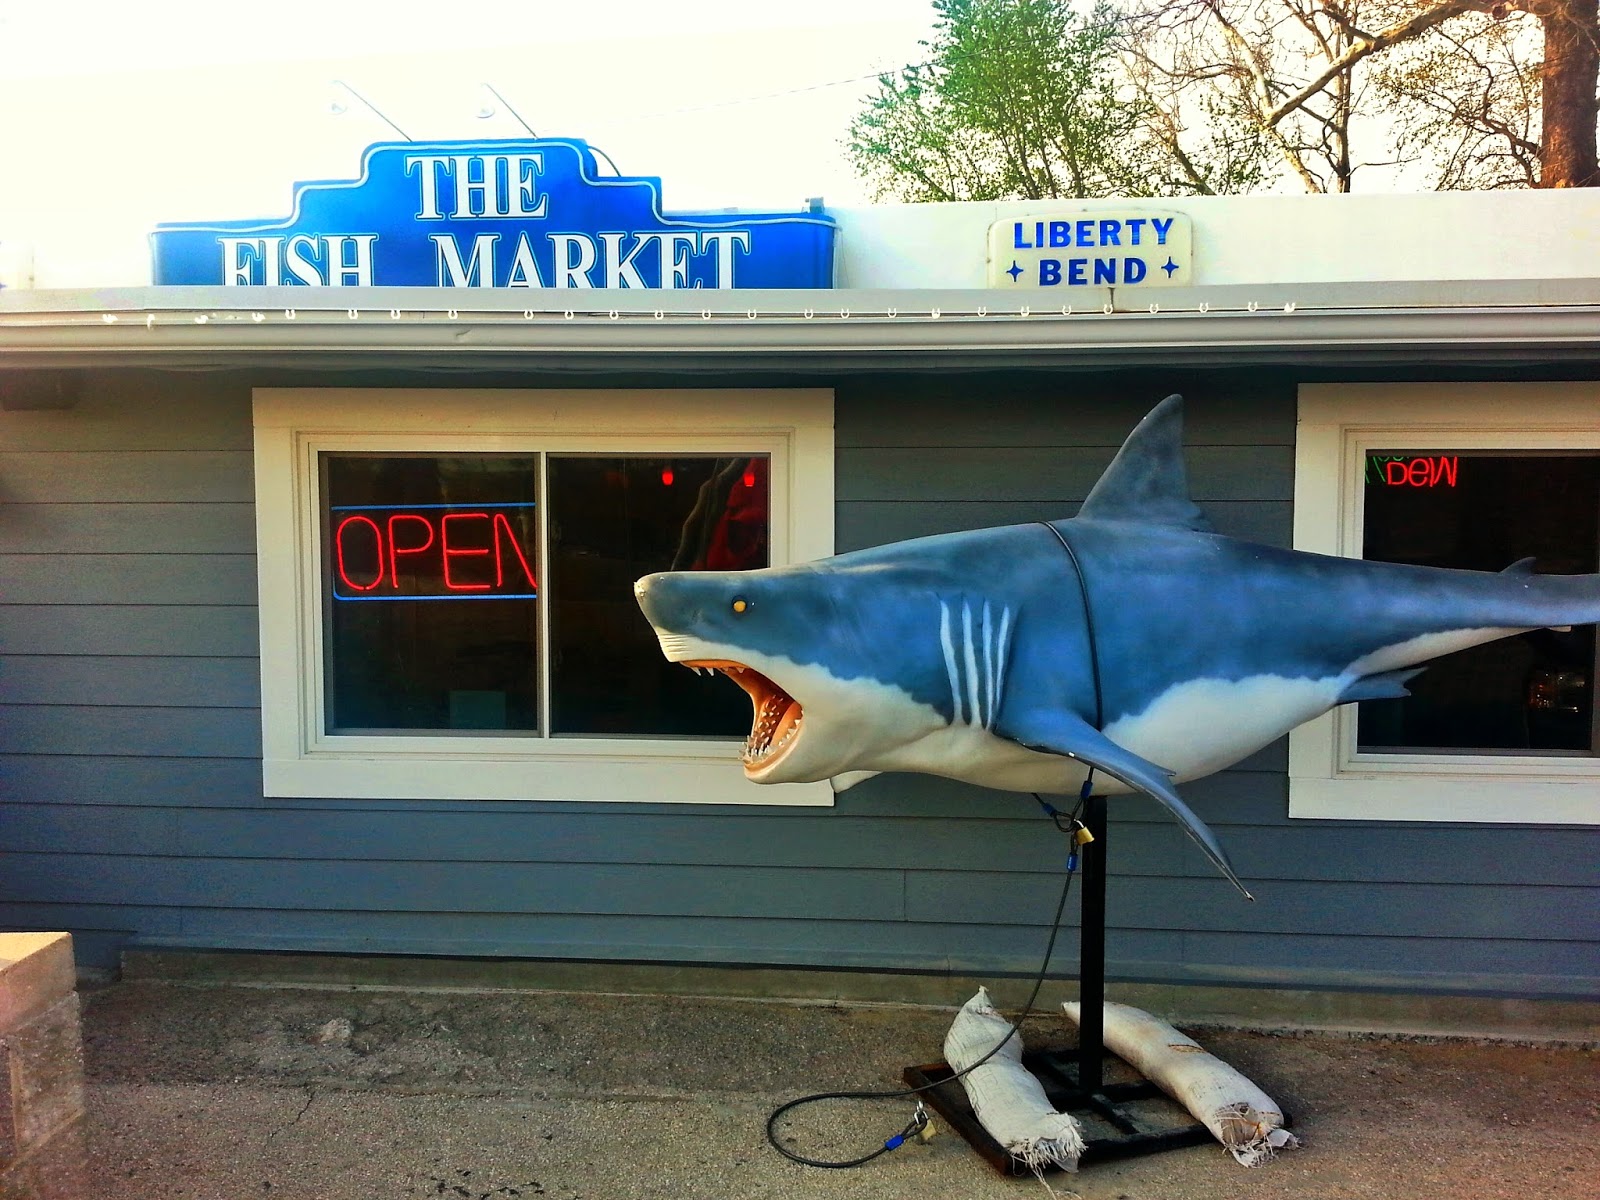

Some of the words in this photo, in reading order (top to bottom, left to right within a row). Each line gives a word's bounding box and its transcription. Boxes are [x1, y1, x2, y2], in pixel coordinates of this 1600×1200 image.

[405, 152, 548, 220] THE
[217, 232, 379, 287] FISH
[429, 231, 751, 289] MARKET
[1014, 218, 1174, 249] LIBERTY
[1038, 257, 1147, 286] BEND
[336, 512, 538, 591] OPEN
